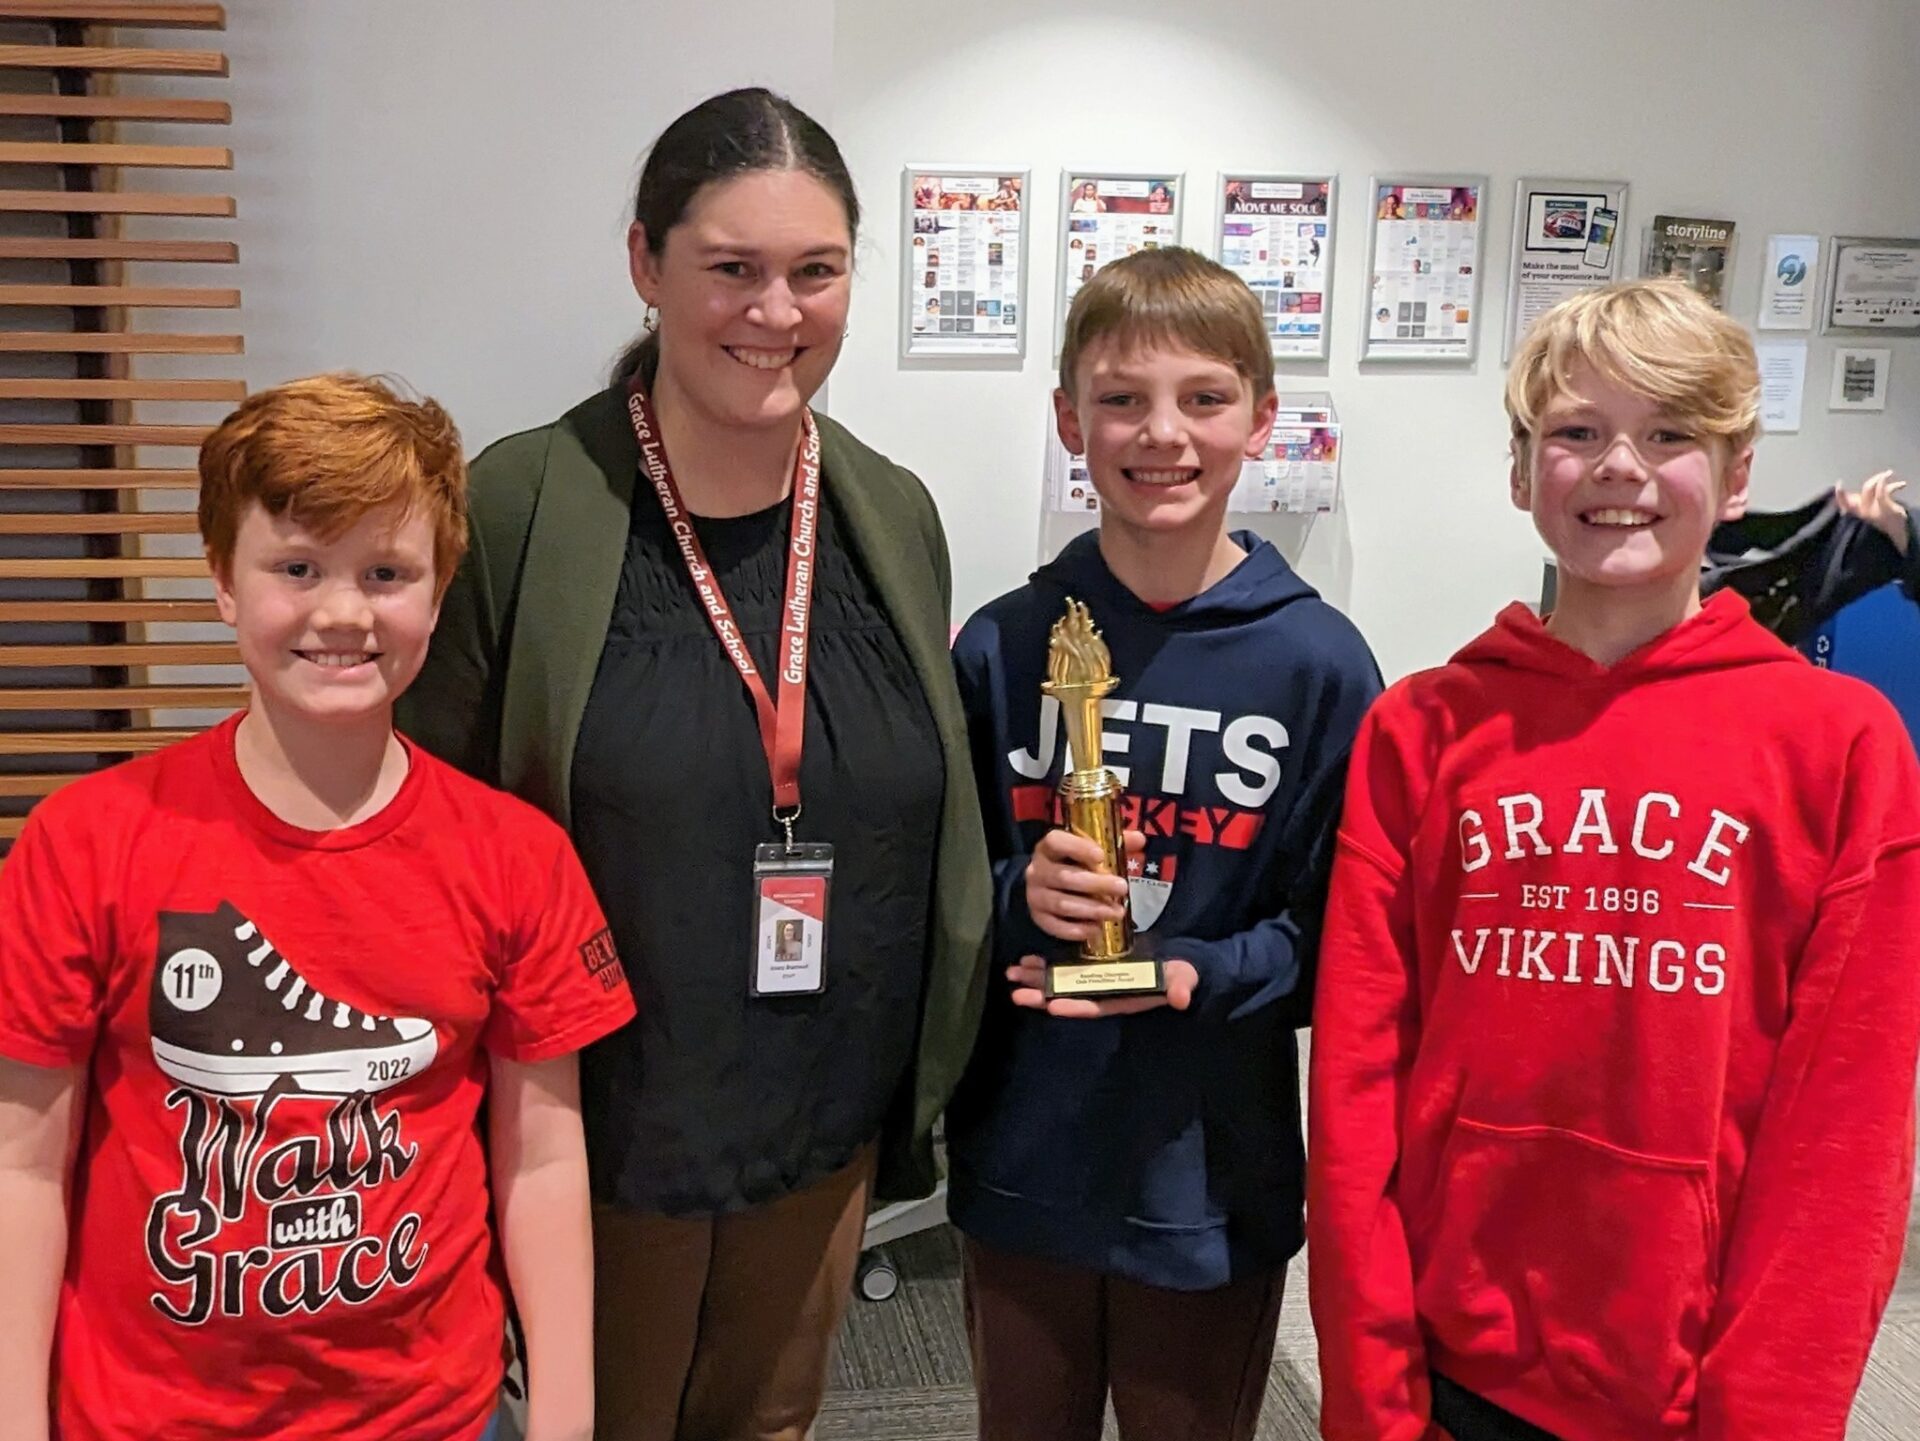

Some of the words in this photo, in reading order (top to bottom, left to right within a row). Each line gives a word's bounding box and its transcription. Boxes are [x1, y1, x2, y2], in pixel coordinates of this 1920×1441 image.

[1233, 202, 1267, 214] MOVE
[1269, 203, 1286, 213] ME
[1289, 203, 1318, 215] SOUL
[1666, 224, 1727, 240] storyline
[1522, 262, 1545, 270] Make
[1547, 262, 1559, 270] the
[1532, 273, 1550, 281] your
[1551, 273, 1592, 281] experience
[802, 464, 818, 497] and
[628, 392, 652, 440] Grace
[643, 442, 680, 519] Lutheran
[673, 520, 706, 581] Church
[699, 583, 726, 616] and
[716, 618, 757, 675] School
[793, 498, 815, 558] Church
[787, 561, 810, 633] Lutheran
[784, 636, 804, 684] Grace
[1007, 694, 1290, 808] JETS
[1458, 788, 1751, 887] GRACE
[1521, 884, 1570, 910] EST
[1584, 886, 1660, 914] 1896
[1451, 927, 1727, 995] VIKINGS
[367, 1057, 411, 1082] 2022
[166, 1072, 420, 1223] Walk
[275, 1197, 356, 1245] with
[145, 1190, 429, 1326] Grace
